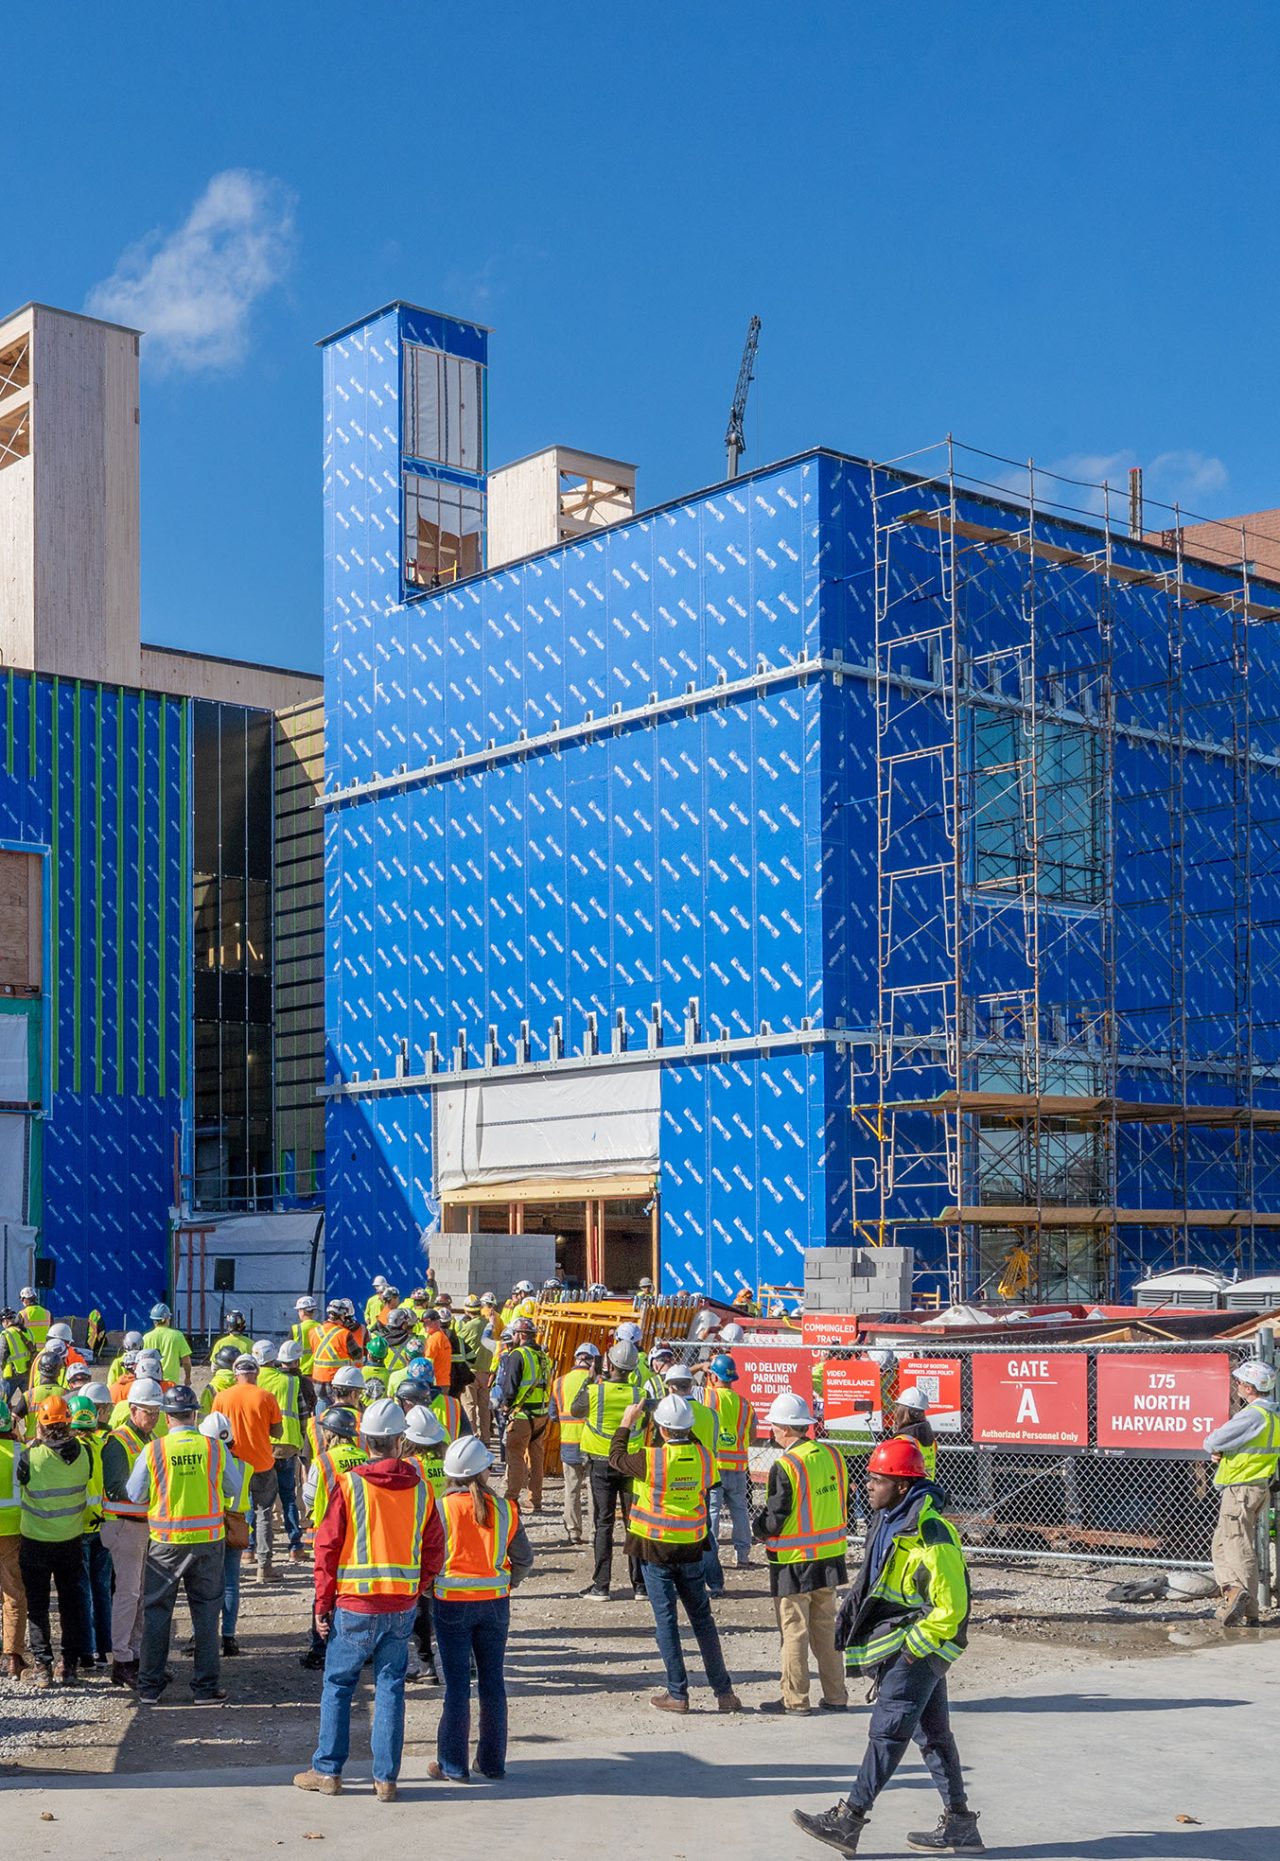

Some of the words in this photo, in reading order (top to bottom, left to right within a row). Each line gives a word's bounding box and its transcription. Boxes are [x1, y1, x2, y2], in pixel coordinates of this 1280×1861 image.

[804, 1323, 855, 1333] COMMINGLED
[816, 1335, 842, 1344] TRASH
[745, 1362, 757, 1372] NO
[759, 1362, 798, 1373] DELIVERY
[1007, 1360, 1049, 1377] GATE
[753, 1373, 789, 1383] PARKING
[826, 1370, 847, 1378] VIDEO
[826, 1379, 875, 1387] SURVEILLANCE
[1148, 1373, 1176, 1389] 175
[750, 1384, 762, 1394] OR
[764, 1384, 792, 1395] IDLING
[1016, 1388, 1040, 1424] A
[1133, 1395, 1191, 1411] NORTH
[1111, 1415, 1188, 1432] HARVARD
[1191, 1417, 1215, 1434] ST
[981, 1429, 1021, 1440] Authorized
[1022, 1430, 1060, 1441] Personnel
[1060, 1432, 1079, 1443] Only
[171, 1454, 203, 1467] SAFETY
[427, 1467, 446, 1479] SAFE
